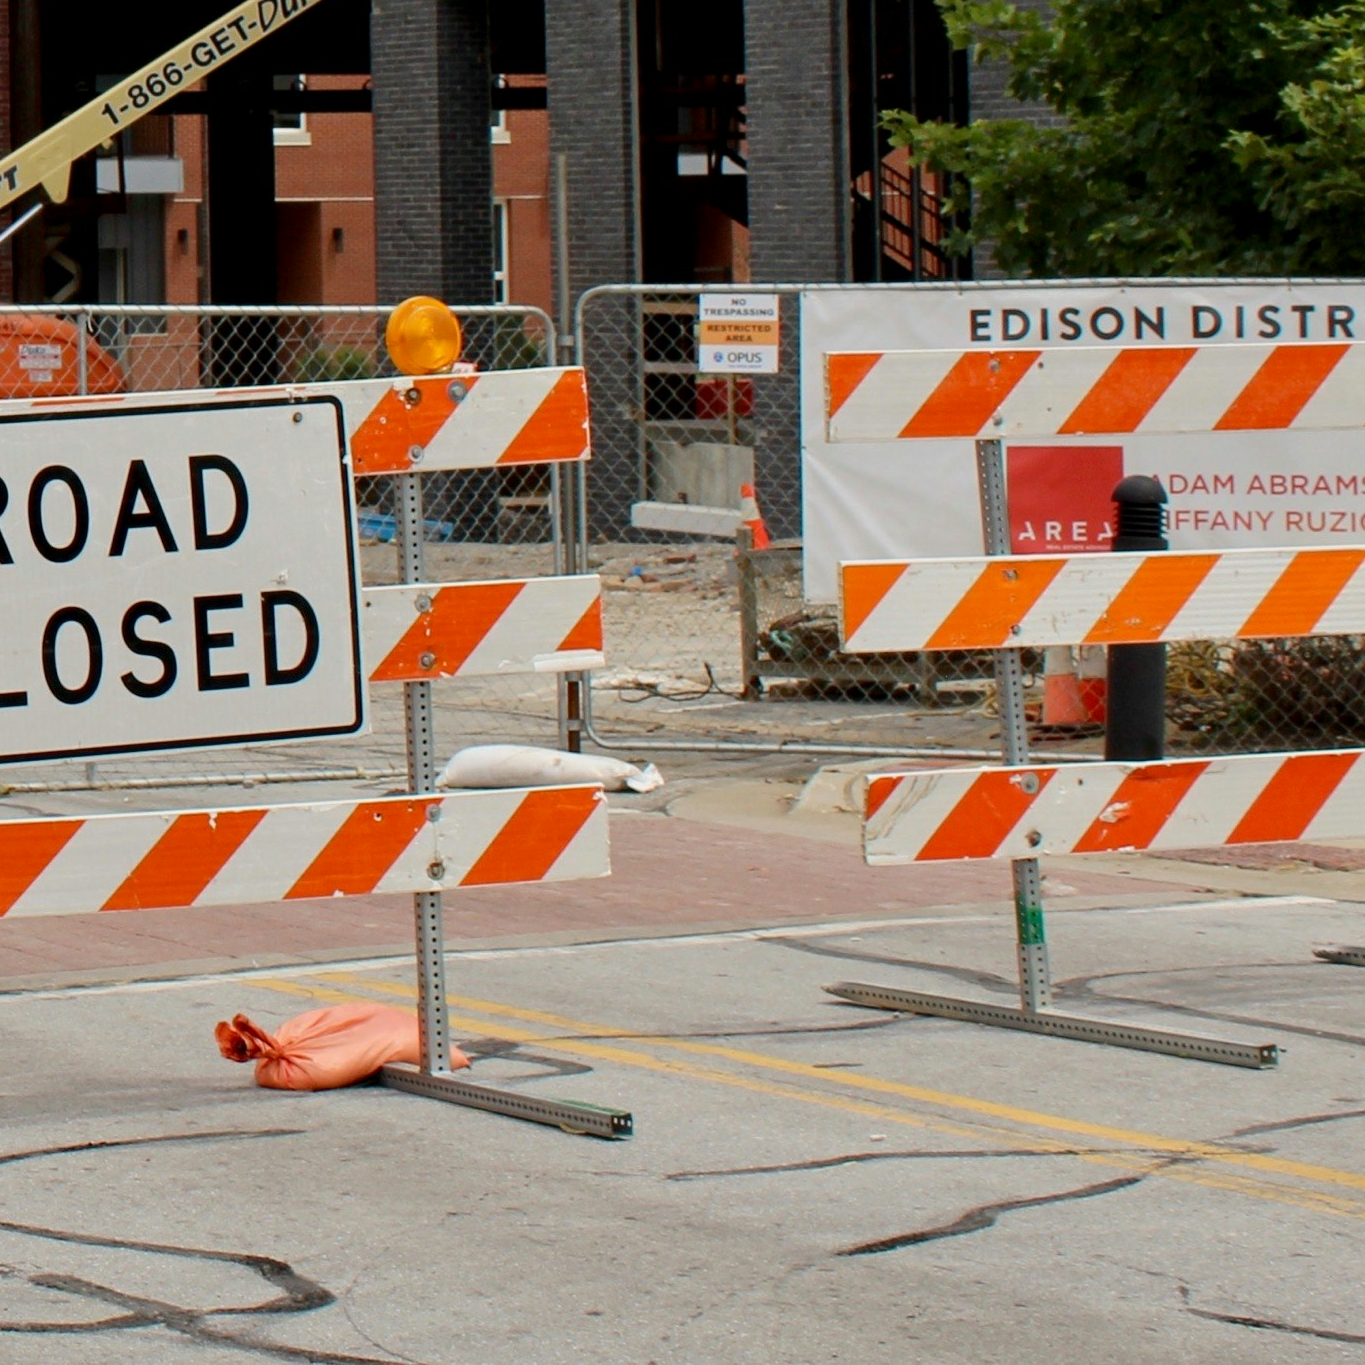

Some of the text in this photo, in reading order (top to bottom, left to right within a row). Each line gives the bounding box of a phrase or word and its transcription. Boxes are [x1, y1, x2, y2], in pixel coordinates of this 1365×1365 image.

[704, 308, 774, 316] TRESPASSING
[707, 324, 771, 332] RESTRICTED
[970, 304, 1355, 342] EDISON DISTR
[727, 352, 762, 363] OPUS
[1153, 474, 1235, 495] DAM
[1019, 520, 1114, 542] AREA
[1166, 509, 1274, 532] IFFANY
